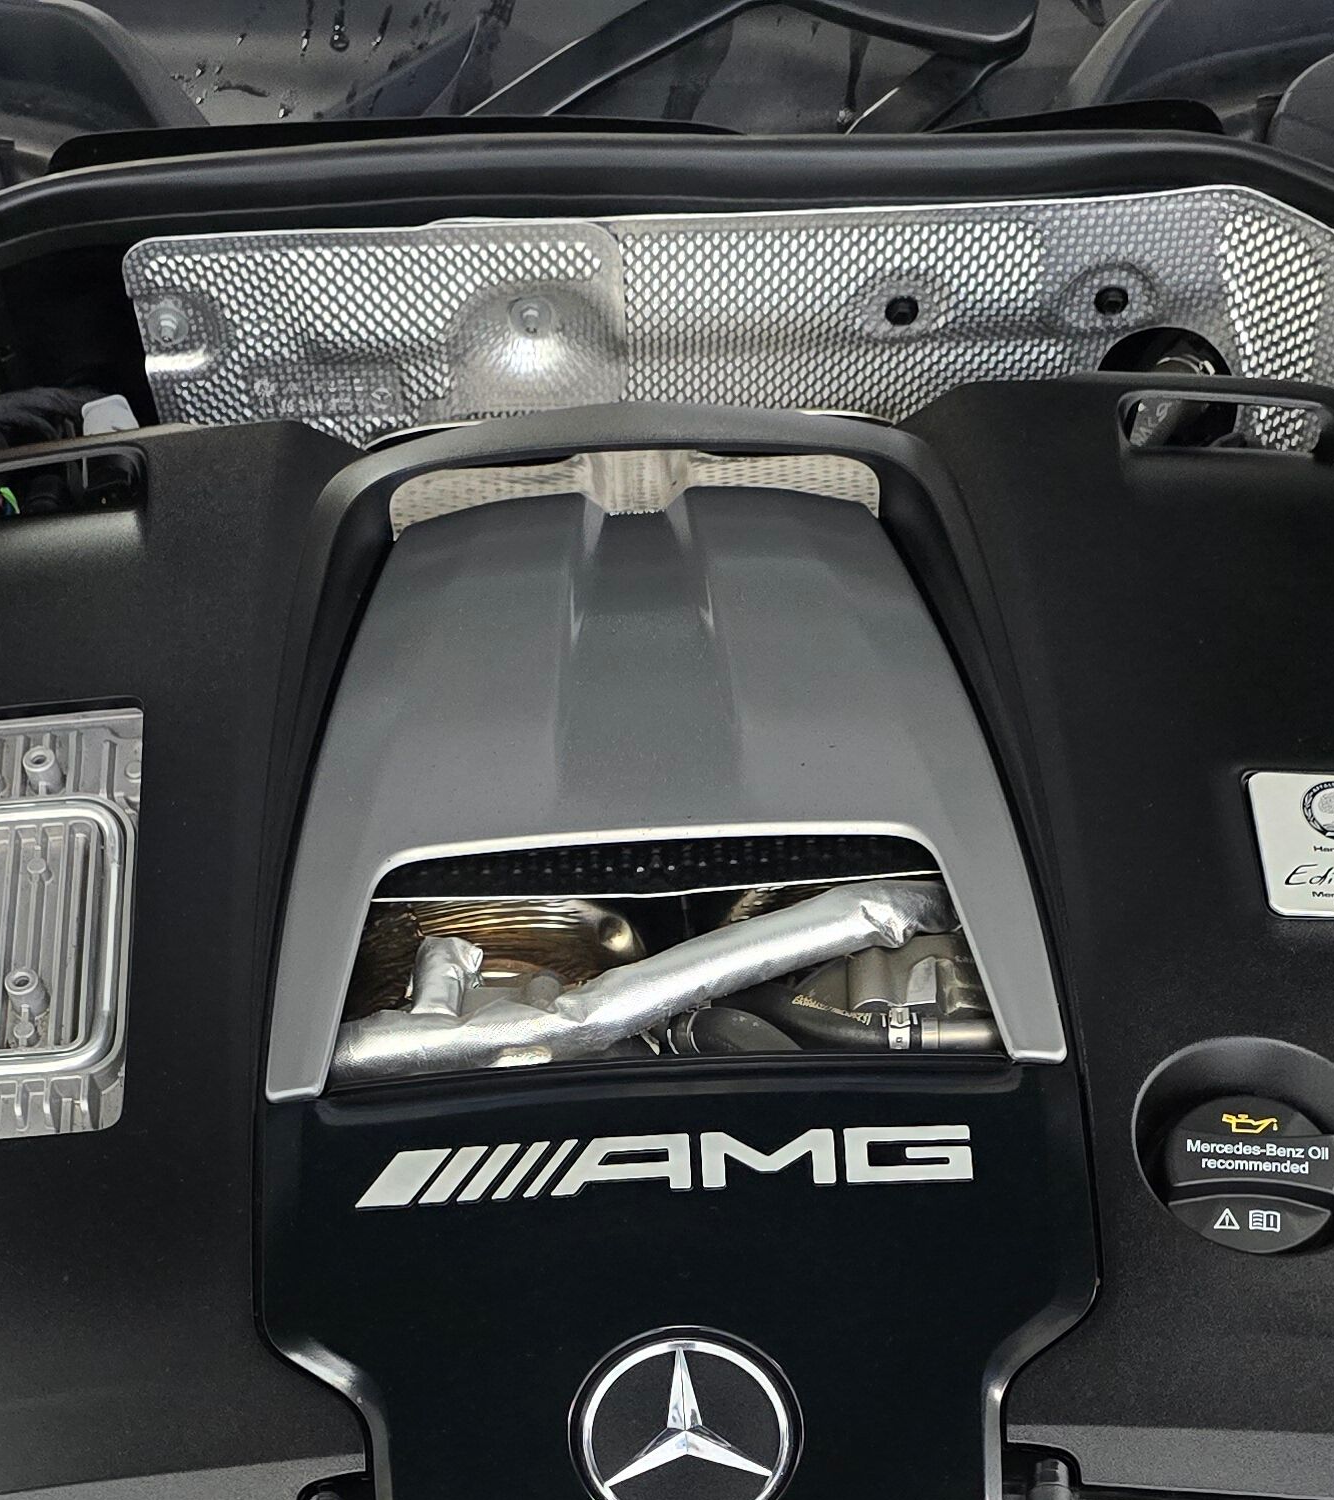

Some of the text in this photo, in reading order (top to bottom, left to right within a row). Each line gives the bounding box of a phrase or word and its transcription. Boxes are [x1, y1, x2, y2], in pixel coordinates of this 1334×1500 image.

[1186, 1138, 1329, 1160] Mercedes-Benz Oil
[551, 1125, 974, 1198] AMG
[1201, 1156, 1310, 1175] recommended
